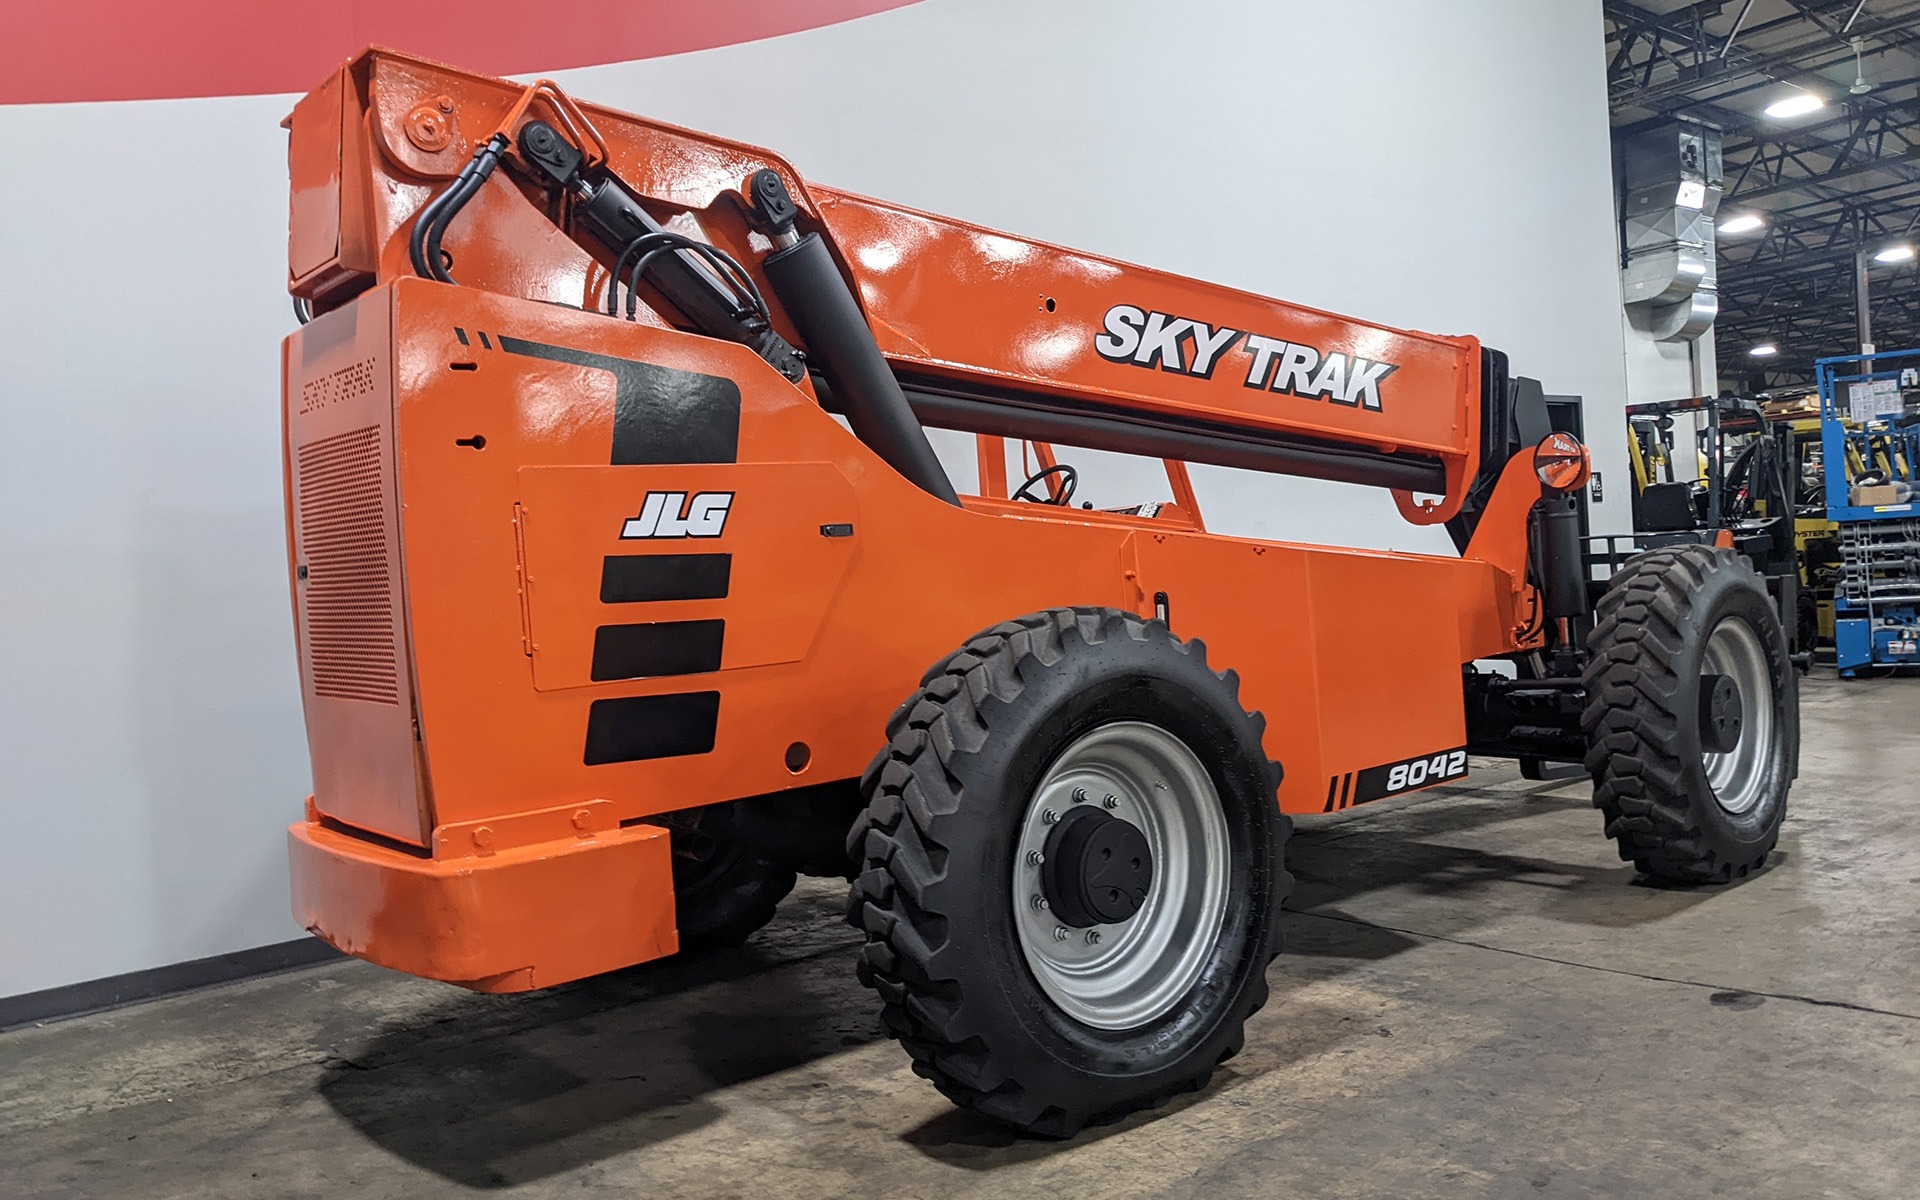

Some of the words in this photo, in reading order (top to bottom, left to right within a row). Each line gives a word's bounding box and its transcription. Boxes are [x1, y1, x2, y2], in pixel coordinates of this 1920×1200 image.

[1095, 304, 1246, 380] SKY
[1243, 334, 1400, 412] TRAK
[300, 374, 332, 415] SKY
[333, 357, 376, 403] TRAK
[619, 491, 736, 540] JLG
[1386, 750, 1467, 792] 8042
